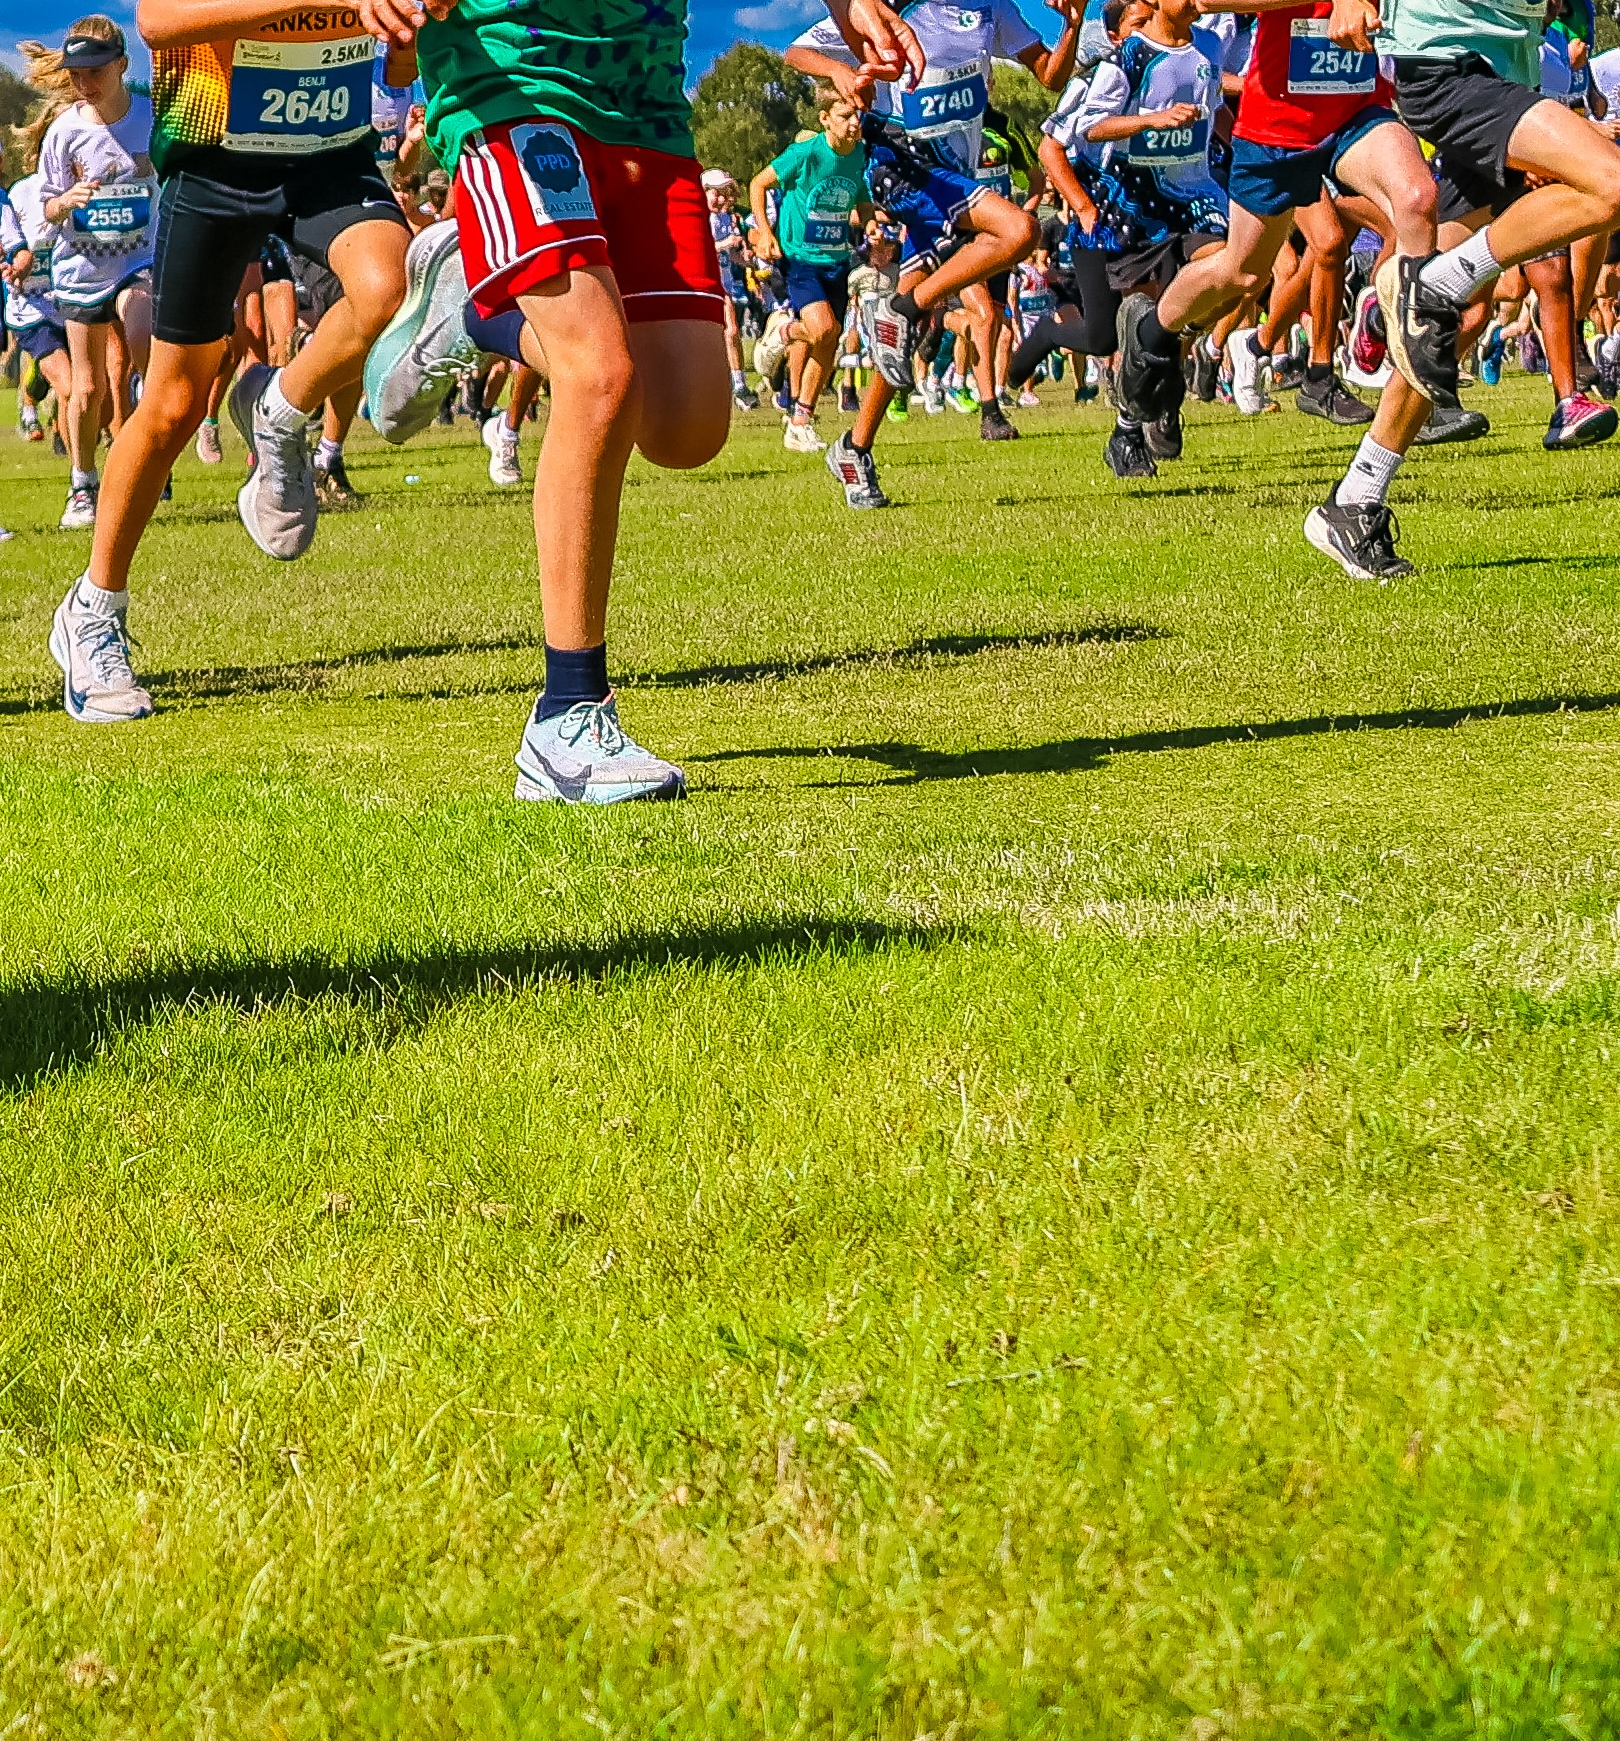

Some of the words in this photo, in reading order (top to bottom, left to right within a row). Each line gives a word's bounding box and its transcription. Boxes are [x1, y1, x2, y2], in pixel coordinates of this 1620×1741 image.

[321, 41, 369, 64] 2.5KM
[1310, 50, 1364, 73] 2547
[299, 76, 327, 87] BENJI
[947, 63, 977, 80] 2.5KM
[260, 86, 350, 124] 2649
[920, 87, 974, 118] 2740
[1146, 128, 1193, 149] 2709
[534, 153, 571, 171] PPD
[563, 200, 594, 212] ESTATE
[87, 207, 135, 226] 2555
